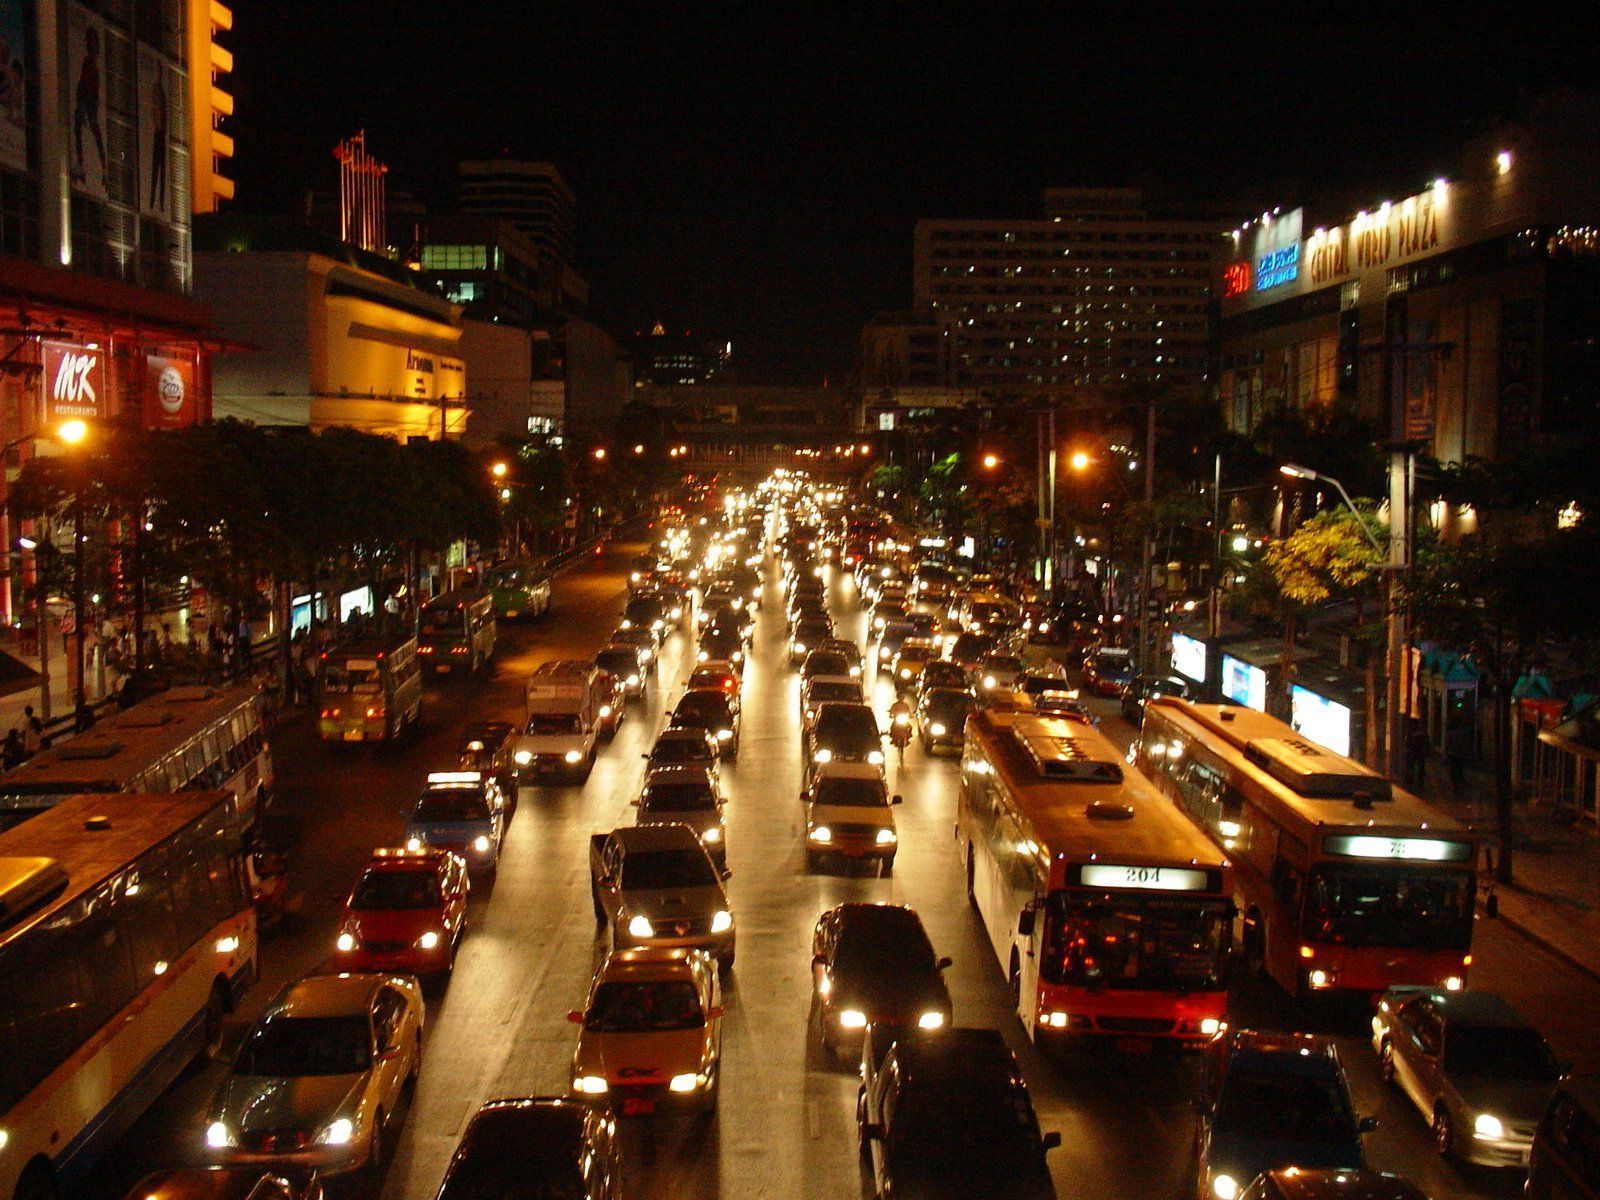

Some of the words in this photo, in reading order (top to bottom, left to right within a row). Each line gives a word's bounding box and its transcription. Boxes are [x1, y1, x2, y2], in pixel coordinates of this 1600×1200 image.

[1398, 204, 1438, 258] PLAZA
[54, 351, 97, 403] MK
[1126, 867, 1161, 883] 204
